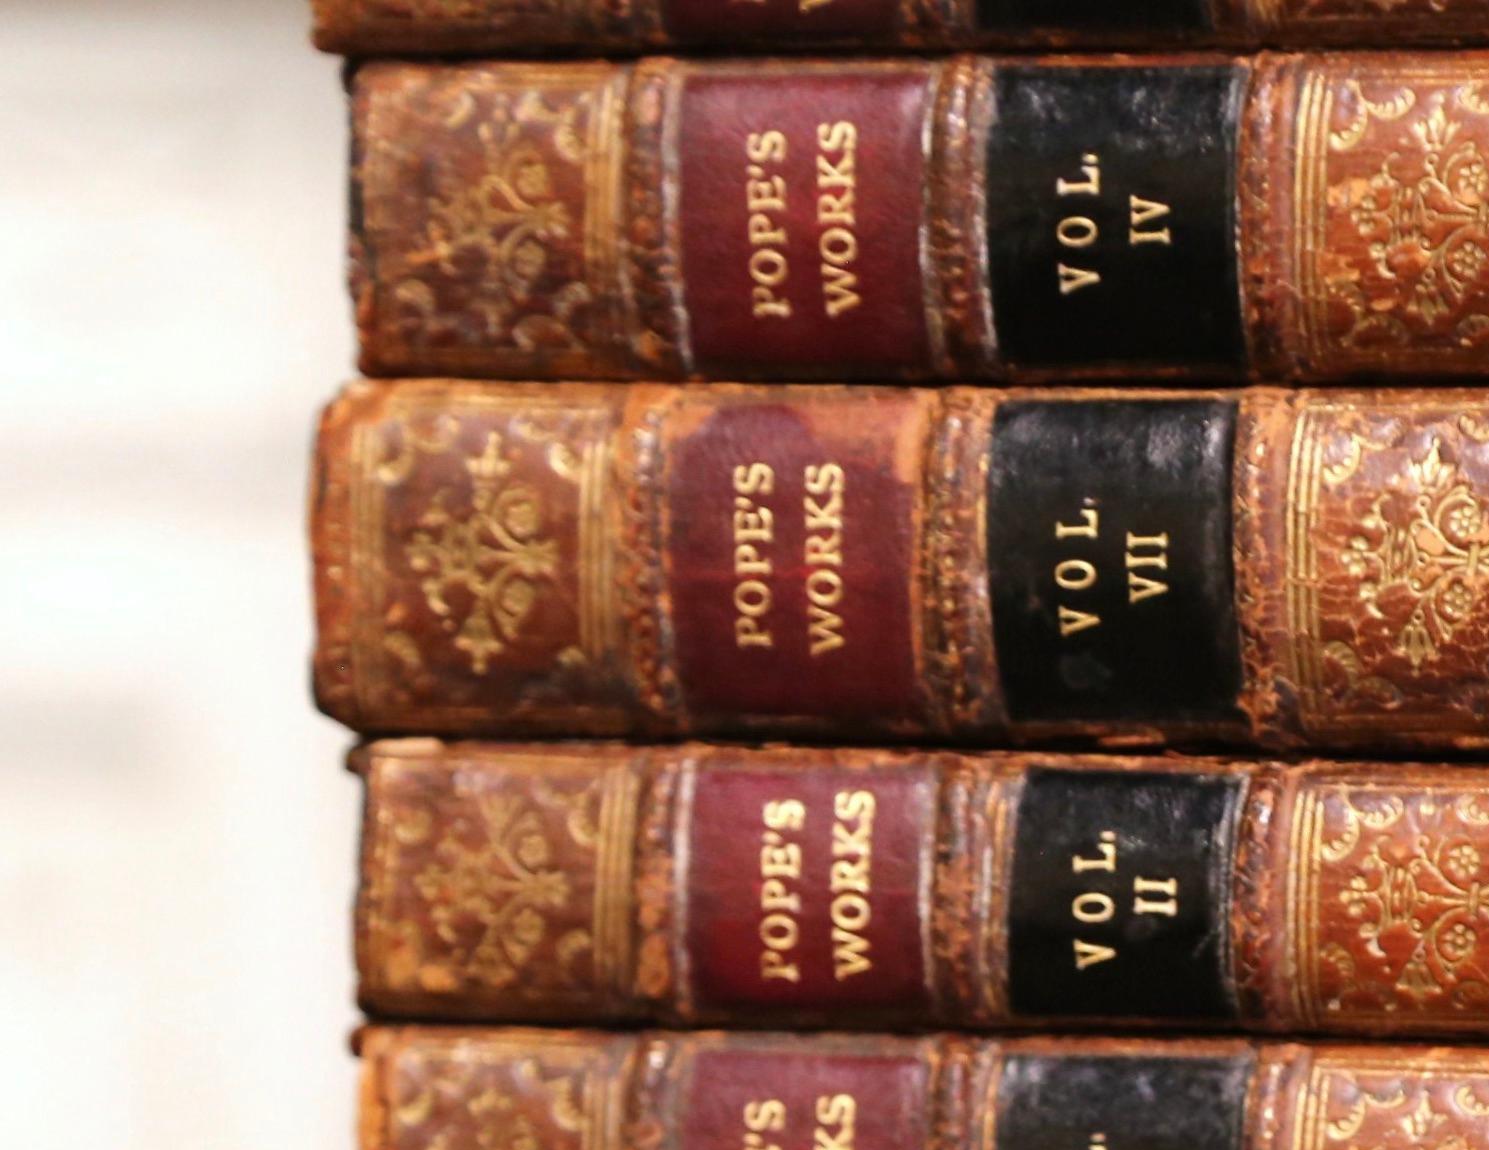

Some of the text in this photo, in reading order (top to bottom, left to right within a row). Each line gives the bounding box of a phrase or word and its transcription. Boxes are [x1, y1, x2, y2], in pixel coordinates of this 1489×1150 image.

[746, 129, 792, 318] POPE'S
[815, 120, 861, 317] WORKS
[1057, 152, 1101, 295] VOL.
[1129, 195, 1171, 245] IV
[733, 462, 775, 651] POPE'S
[805, 462, 845, 655] WORKS
[1055, 496, 1101, 637] VOL.
[1124, 531, 1169, 603] VII
[760, 799, 806, 983] POPE'S
[829, 790, 875, 982] WORKS
[1072, 830, 1117, 970] VOL.
[1134, 876, 1177, 917] II
